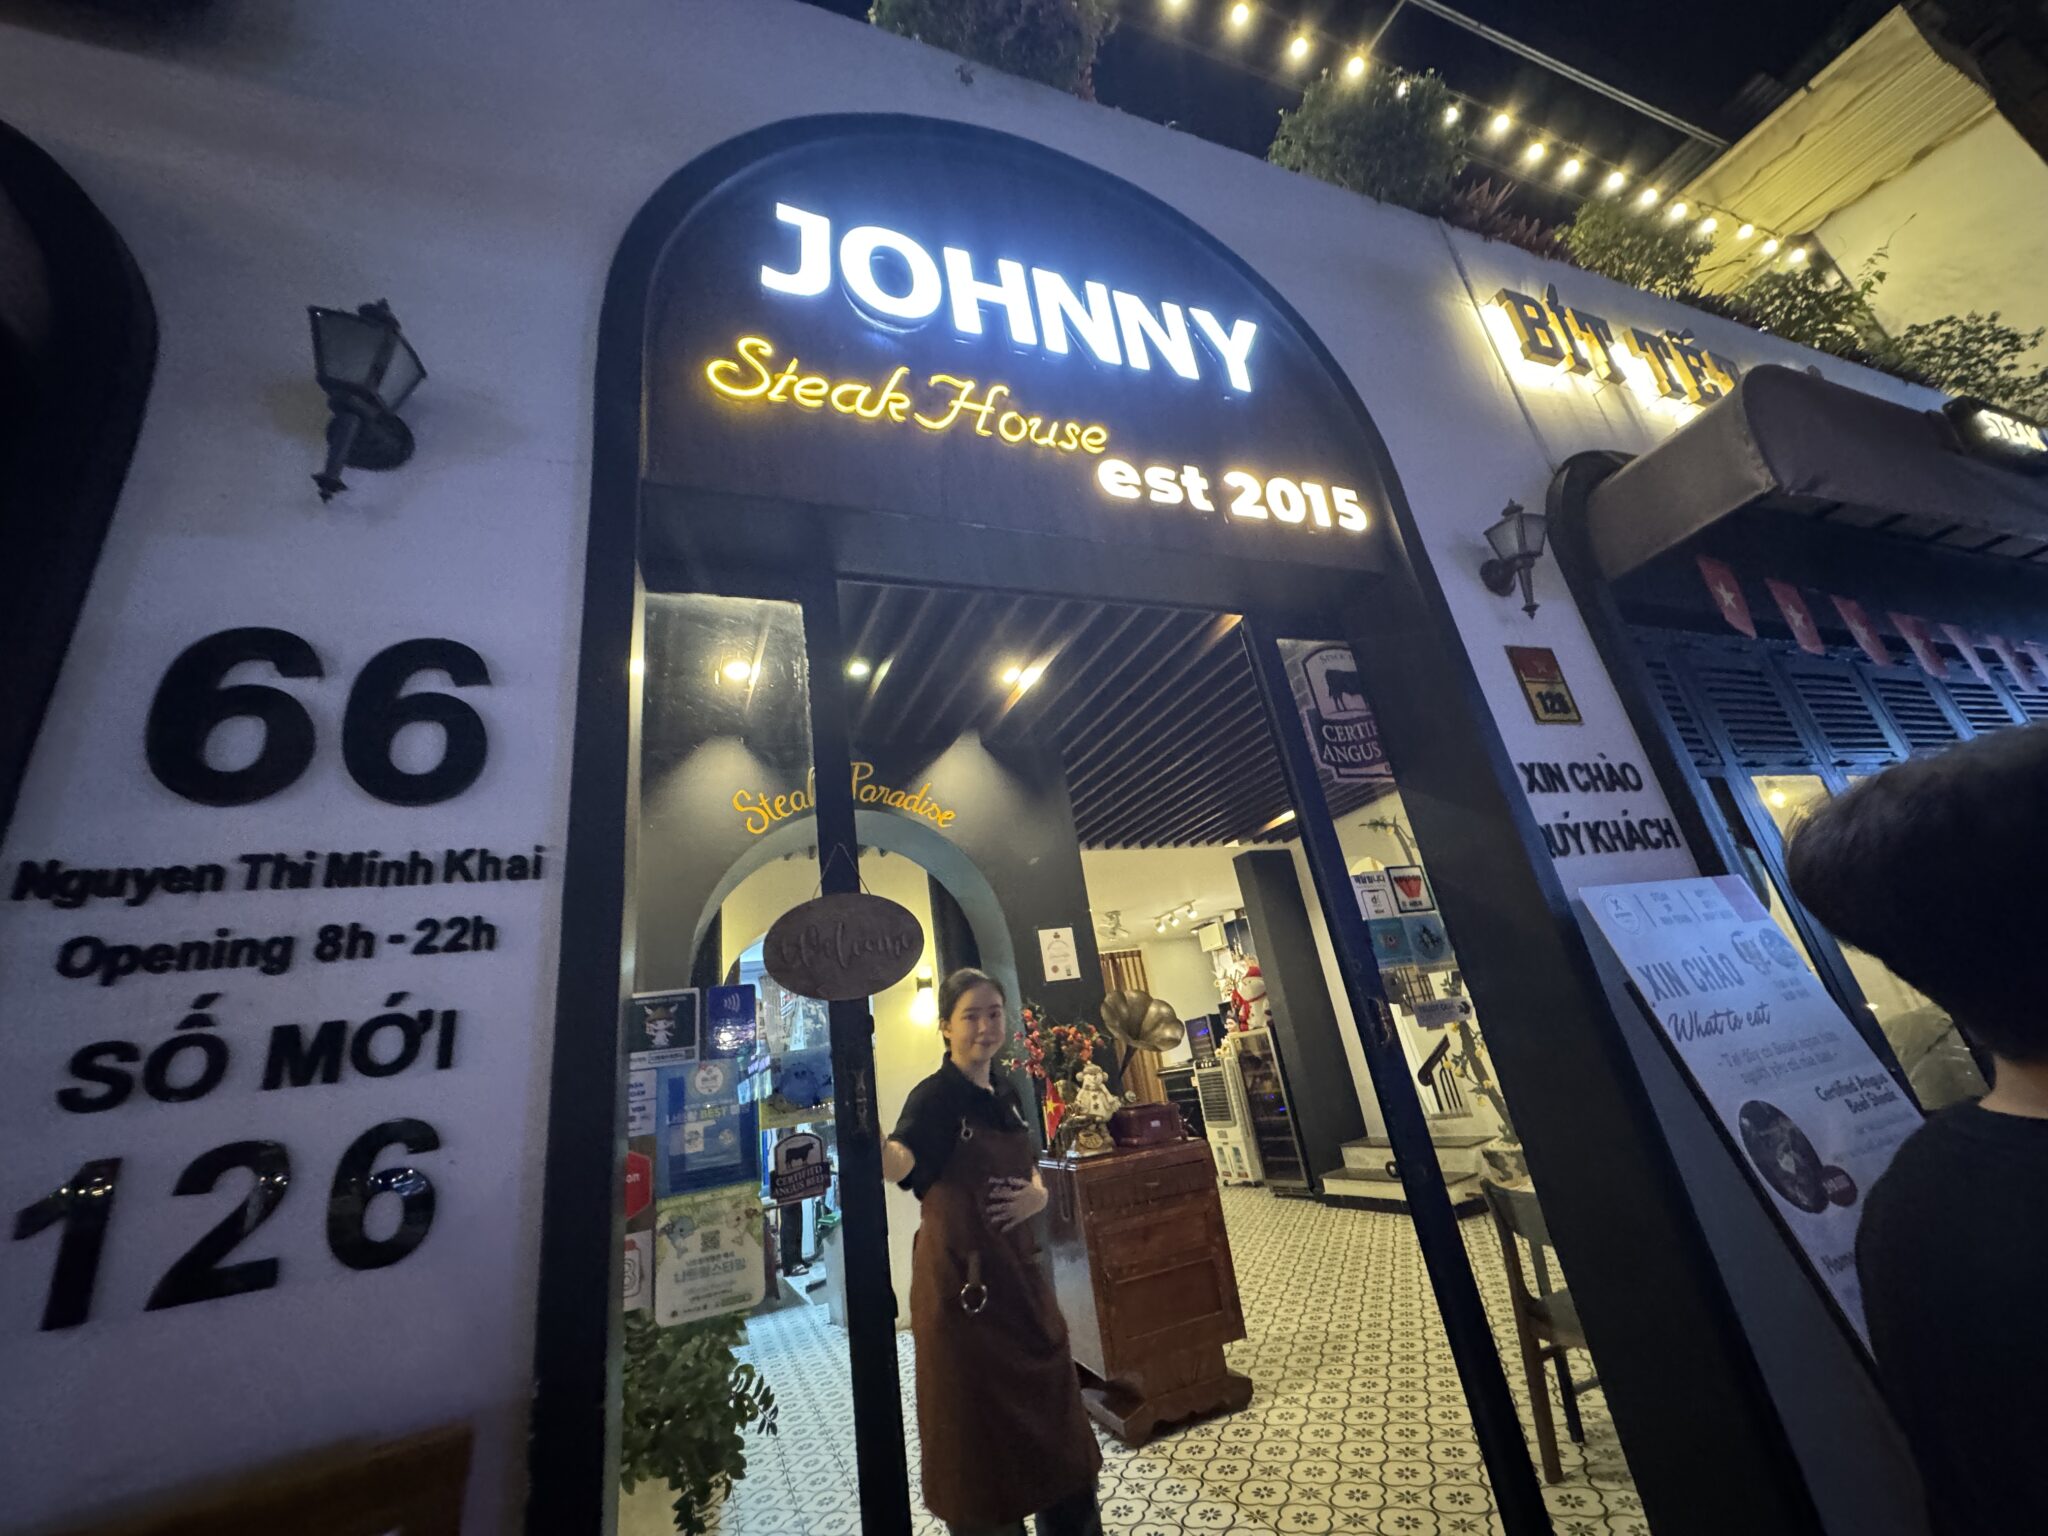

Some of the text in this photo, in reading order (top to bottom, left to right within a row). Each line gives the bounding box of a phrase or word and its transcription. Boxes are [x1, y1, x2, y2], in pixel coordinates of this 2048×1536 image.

[760, 202, 1257, 393] JOHNNY
[1494, 283, 1626, 385] BÍT
[706, 336, 1108, 453] Steak House
[1097, 458, 1369, 533] est 2015
[145, 626, 491, 807] 66
[1323, 741, 1382, 763] ANGUS
[1517, 752, 1643, 793] XIN CHÀO
[850, 761, 957, 828] Paradise
[1583, 809, 1681, 853] KHÁCH
[12, 845, 546, 909] Nguyen Thi Minh Khai
[56, 928, 294, 987] Opening
[313, 922, 376, 963] 8h
[1637, 961, 1691, 1001] XIN
[1681, 946, 1745, 993] CHÀO
[56, 991, 457, 1114] SỐ MỚI
[1668, 1002, 1771, 1042] What to eat
[12, 1117, 441, 1332] 126
